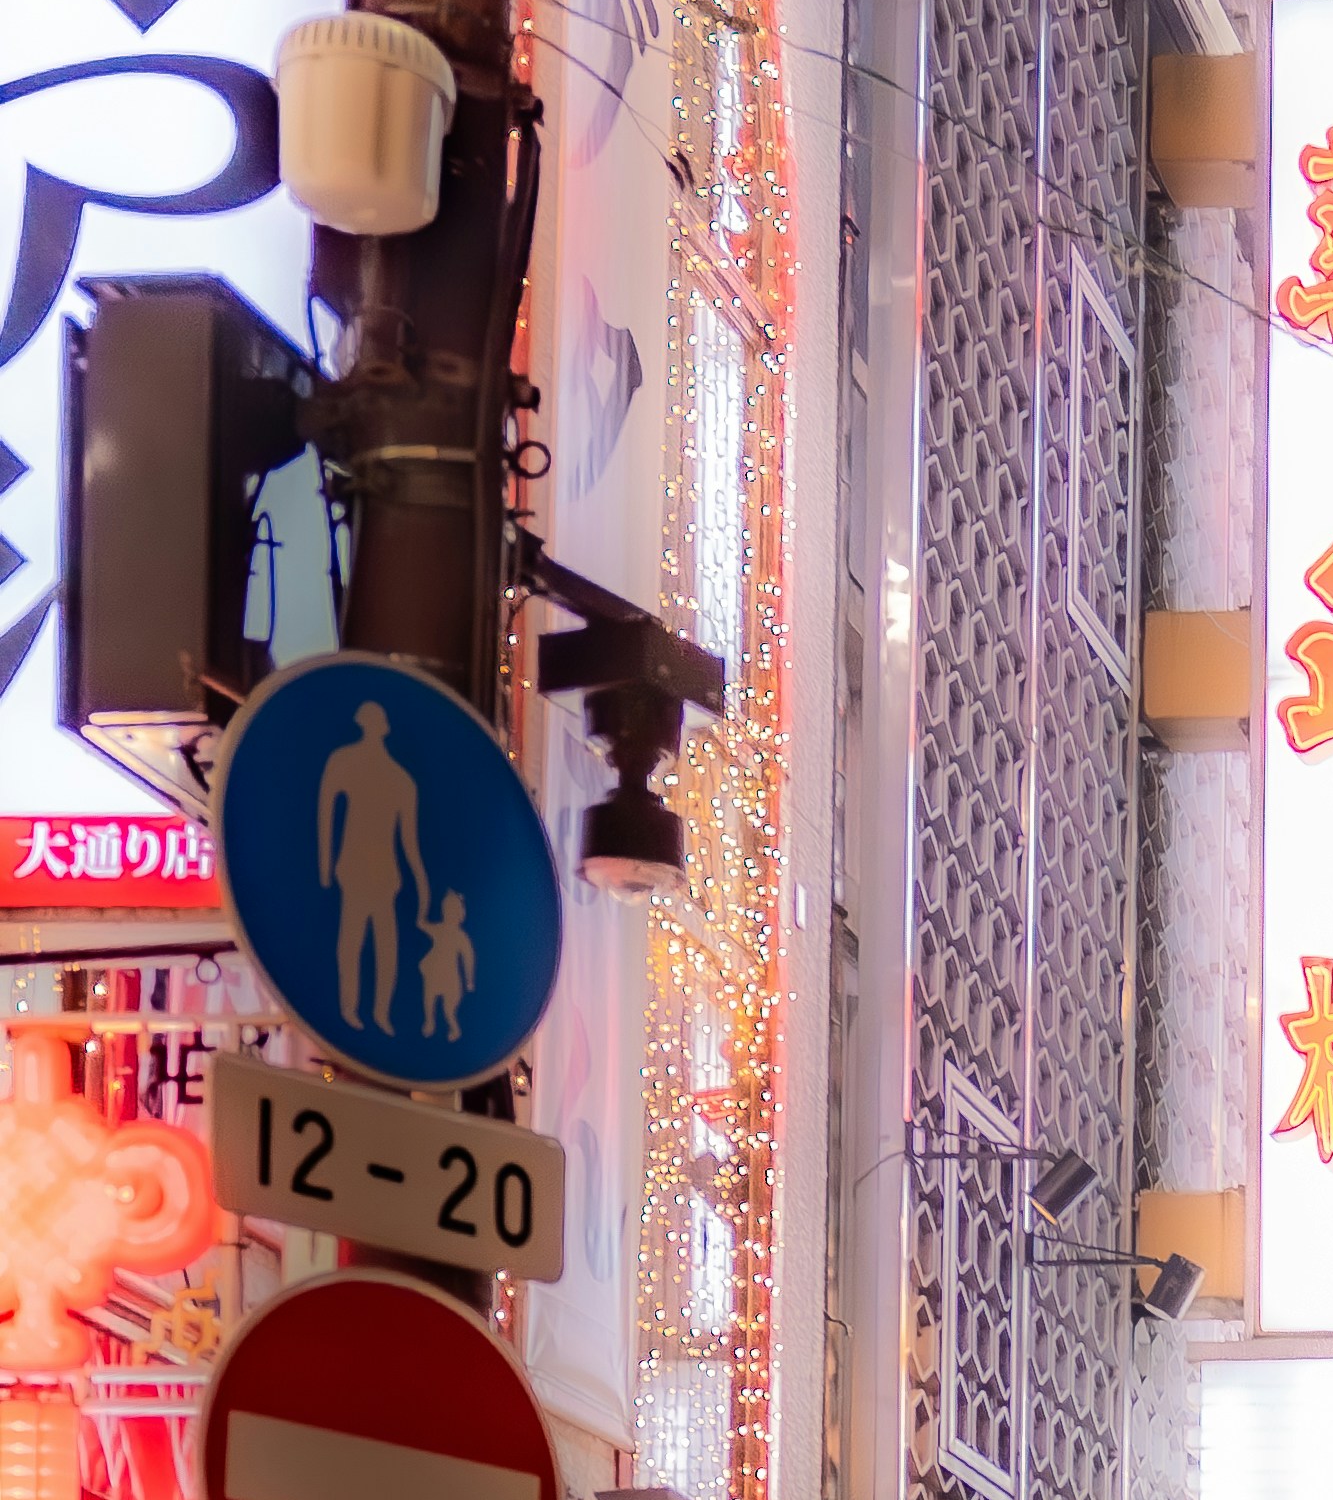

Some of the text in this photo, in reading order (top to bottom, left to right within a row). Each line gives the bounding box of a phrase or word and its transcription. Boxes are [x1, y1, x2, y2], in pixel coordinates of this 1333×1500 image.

[14, 804, 216, 882] 大通り店
[257, 1096, 533, 1248] 12-20
